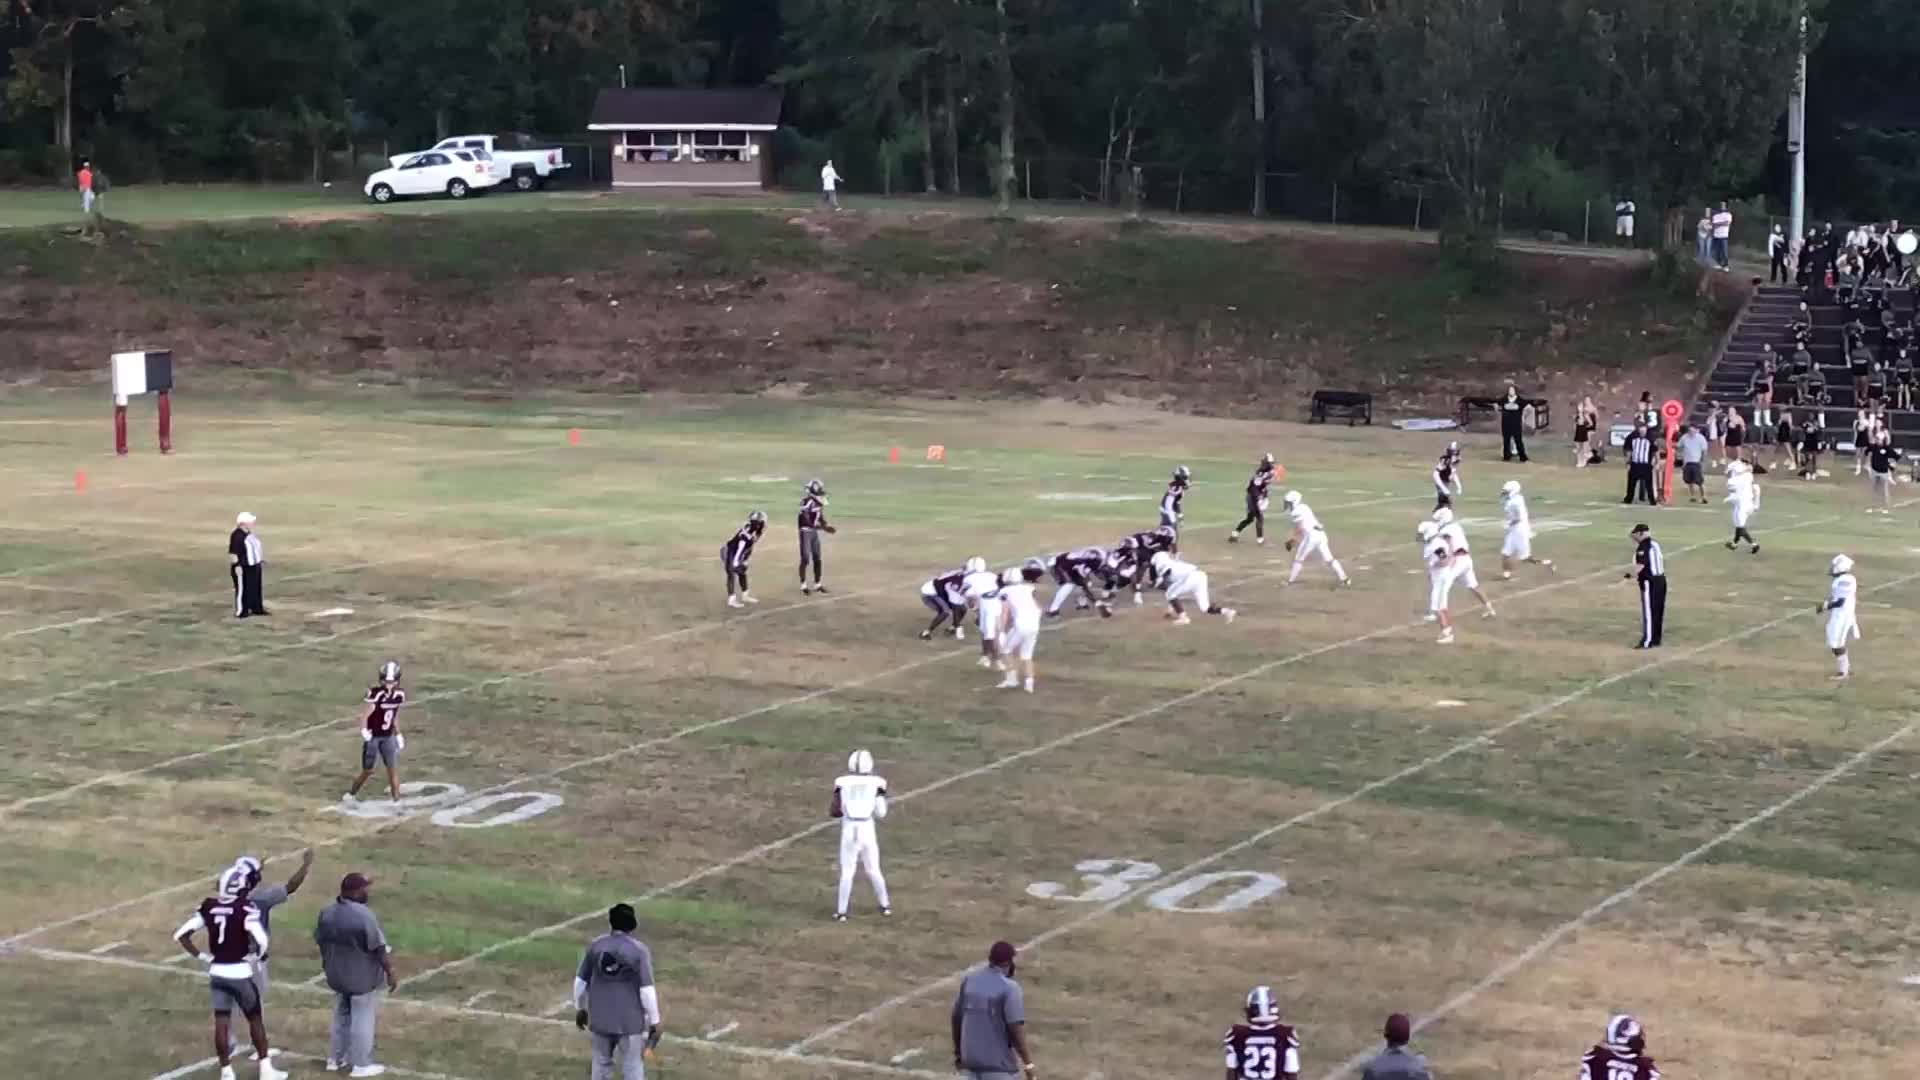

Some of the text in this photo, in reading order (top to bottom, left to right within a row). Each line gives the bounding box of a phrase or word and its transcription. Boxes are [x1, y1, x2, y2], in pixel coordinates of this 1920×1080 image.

[381, 710, 394, 730] 9
[1025, 858, 1288, 912] 30
[214, 915, 226, 944] 7
[1244, 1046, 1277, 1079] 23
